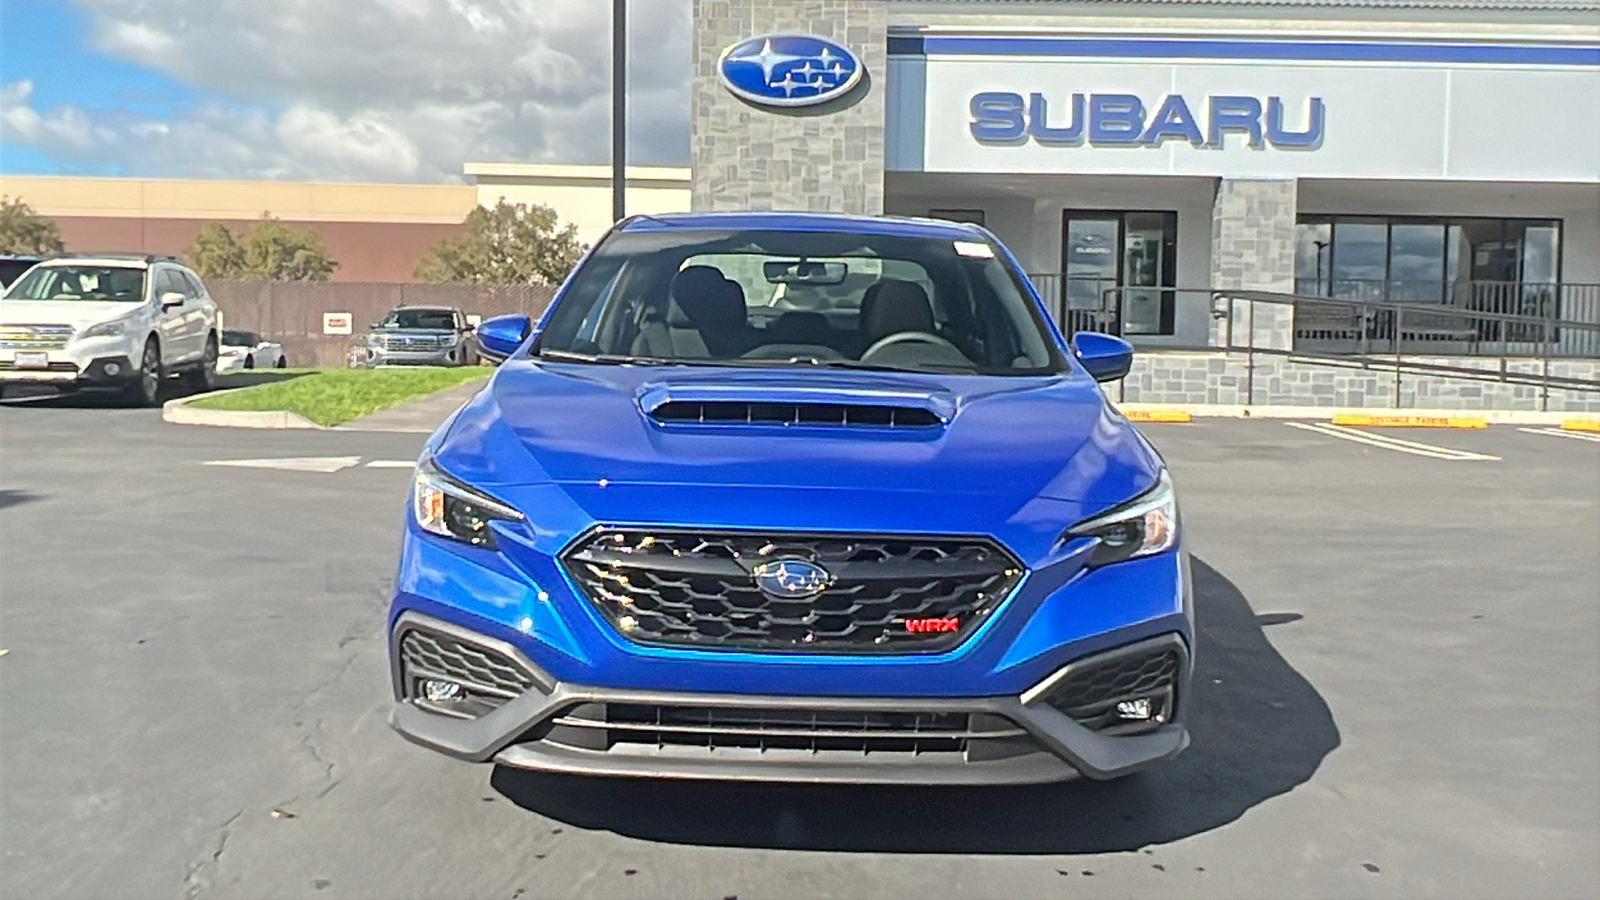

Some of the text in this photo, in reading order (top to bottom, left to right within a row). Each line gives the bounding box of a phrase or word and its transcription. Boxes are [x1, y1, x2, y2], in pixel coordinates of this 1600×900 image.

[969, 91, 1324, 149] SUBARU
[1076, 246, 1110, 254] SUBARU
[905, 617, 959, 633] WRX
